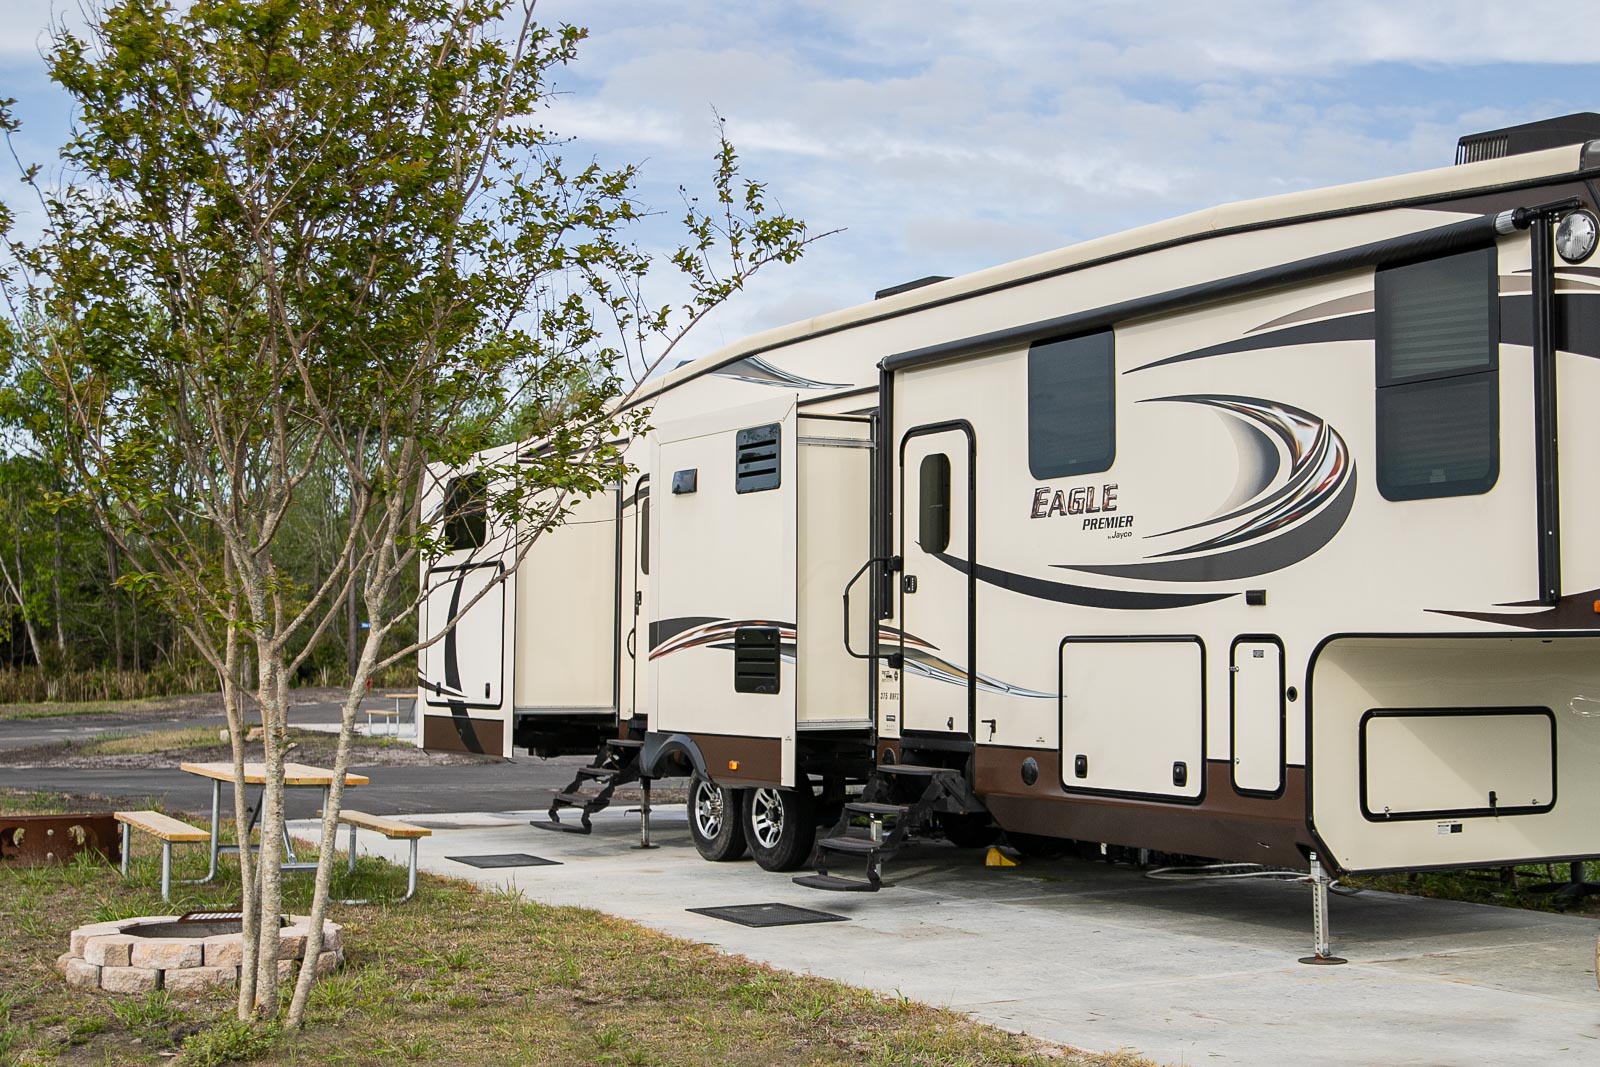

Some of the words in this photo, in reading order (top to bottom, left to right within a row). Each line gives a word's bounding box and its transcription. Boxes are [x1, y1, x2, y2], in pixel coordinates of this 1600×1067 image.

[1030, 483, 1118, 519] EAGLE
[1082, 515, 1134, 531] PREMIER
[1111, 530, 1133, 540] Jayco
